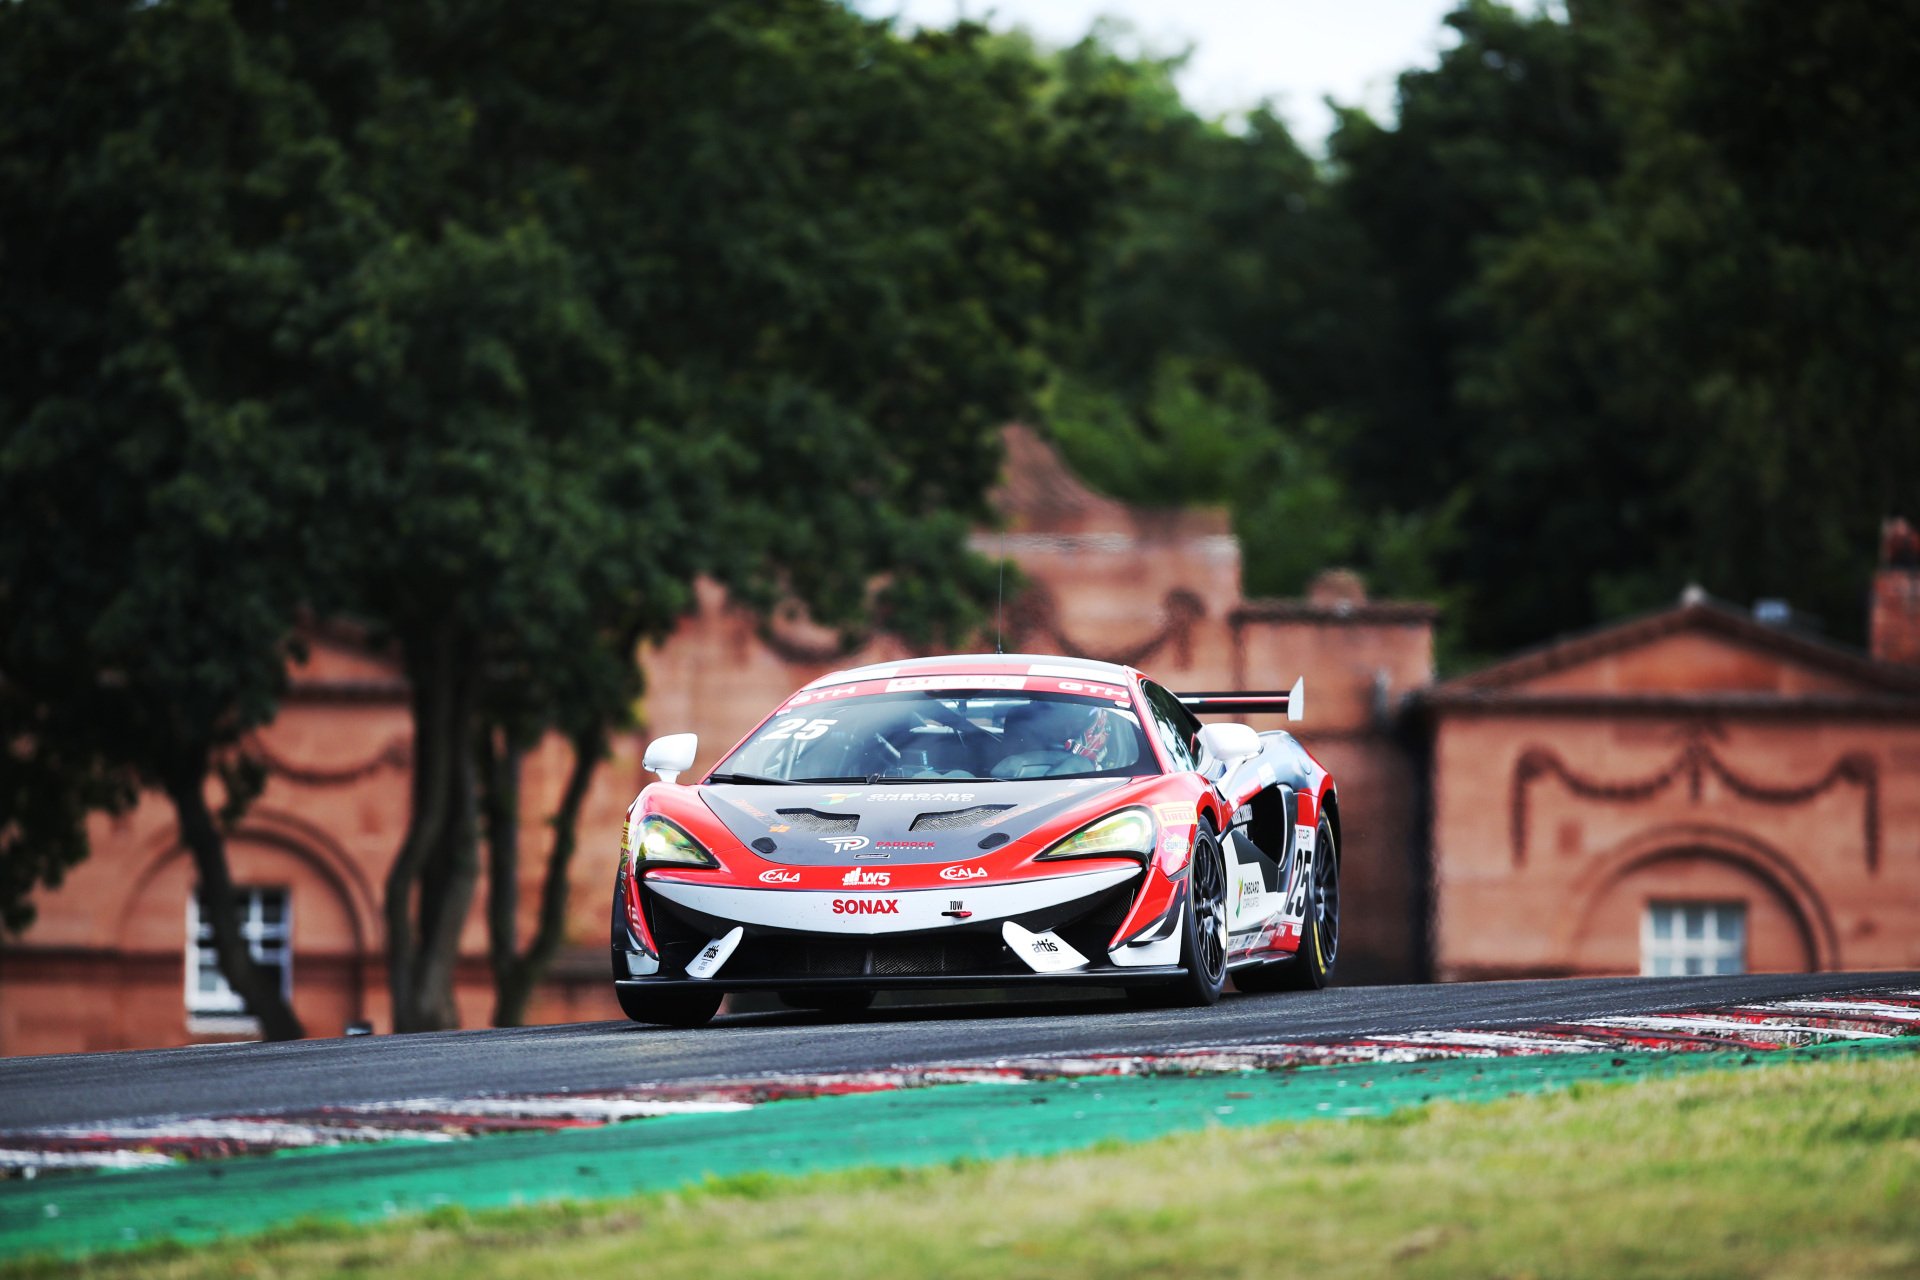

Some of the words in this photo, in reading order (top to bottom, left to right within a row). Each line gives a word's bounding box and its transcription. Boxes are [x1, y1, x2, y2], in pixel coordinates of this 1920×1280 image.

[1058, 682, 1129, 699] GTH
[760, 718, 837, 741] 25
[760, 869, 800, 883] CALA
[862, 872, 891, 886] W5
[947, 866, 988, 880] CALA
[1285, 848, 1313, 918] 25
[832, 899, 899, 915] SONAX
[949, 900, 963, 911] TOW
[1032, 938, 1059, 953] attis
